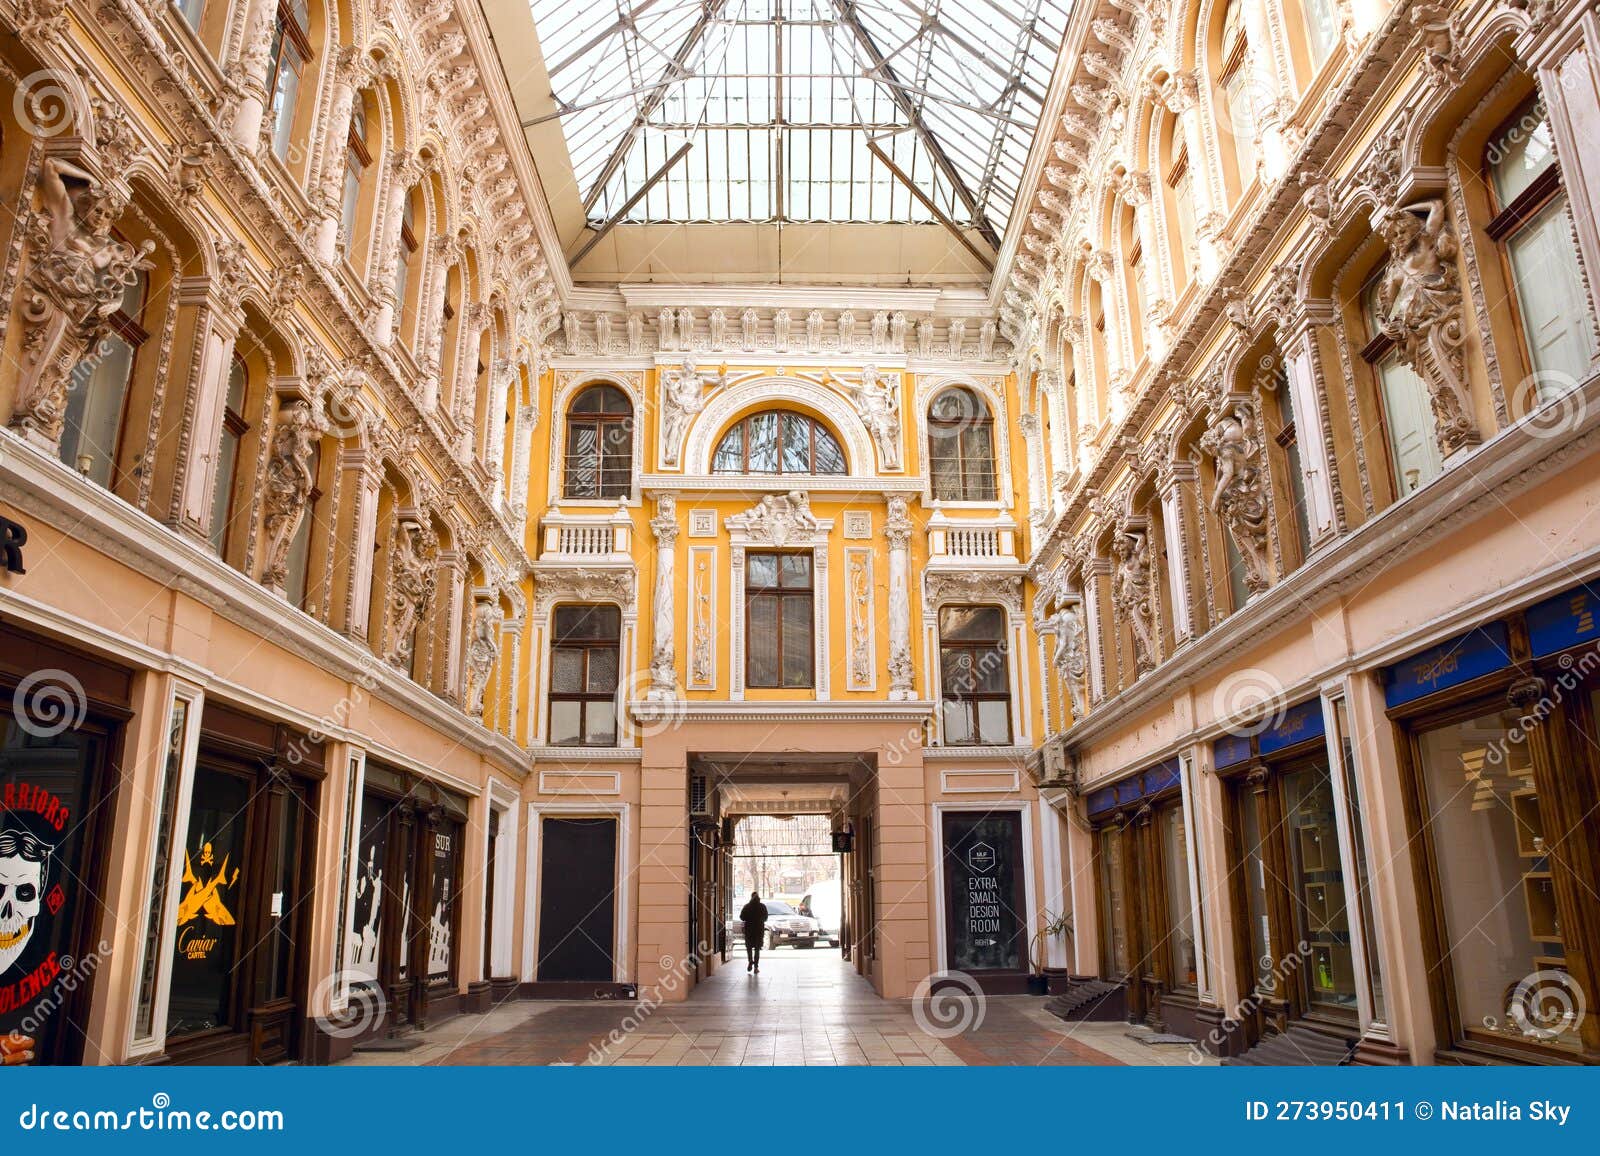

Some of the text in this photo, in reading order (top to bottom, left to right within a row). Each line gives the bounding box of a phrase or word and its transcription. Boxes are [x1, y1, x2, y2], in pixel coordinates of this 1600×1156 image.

[0, 783, 69, 831] RRIORS
[435, 834, 450, 851] SUR
[968, 877, 998, 890] EXTRA
[969, 891, 998, 904] SMALL
[969, 905, 1000, 918] DESIGN
[970, 919, 1000, 933] ROOM
[178, 926, 217, 954] Caviar
[187, 951, 206, 959] CARTEL
